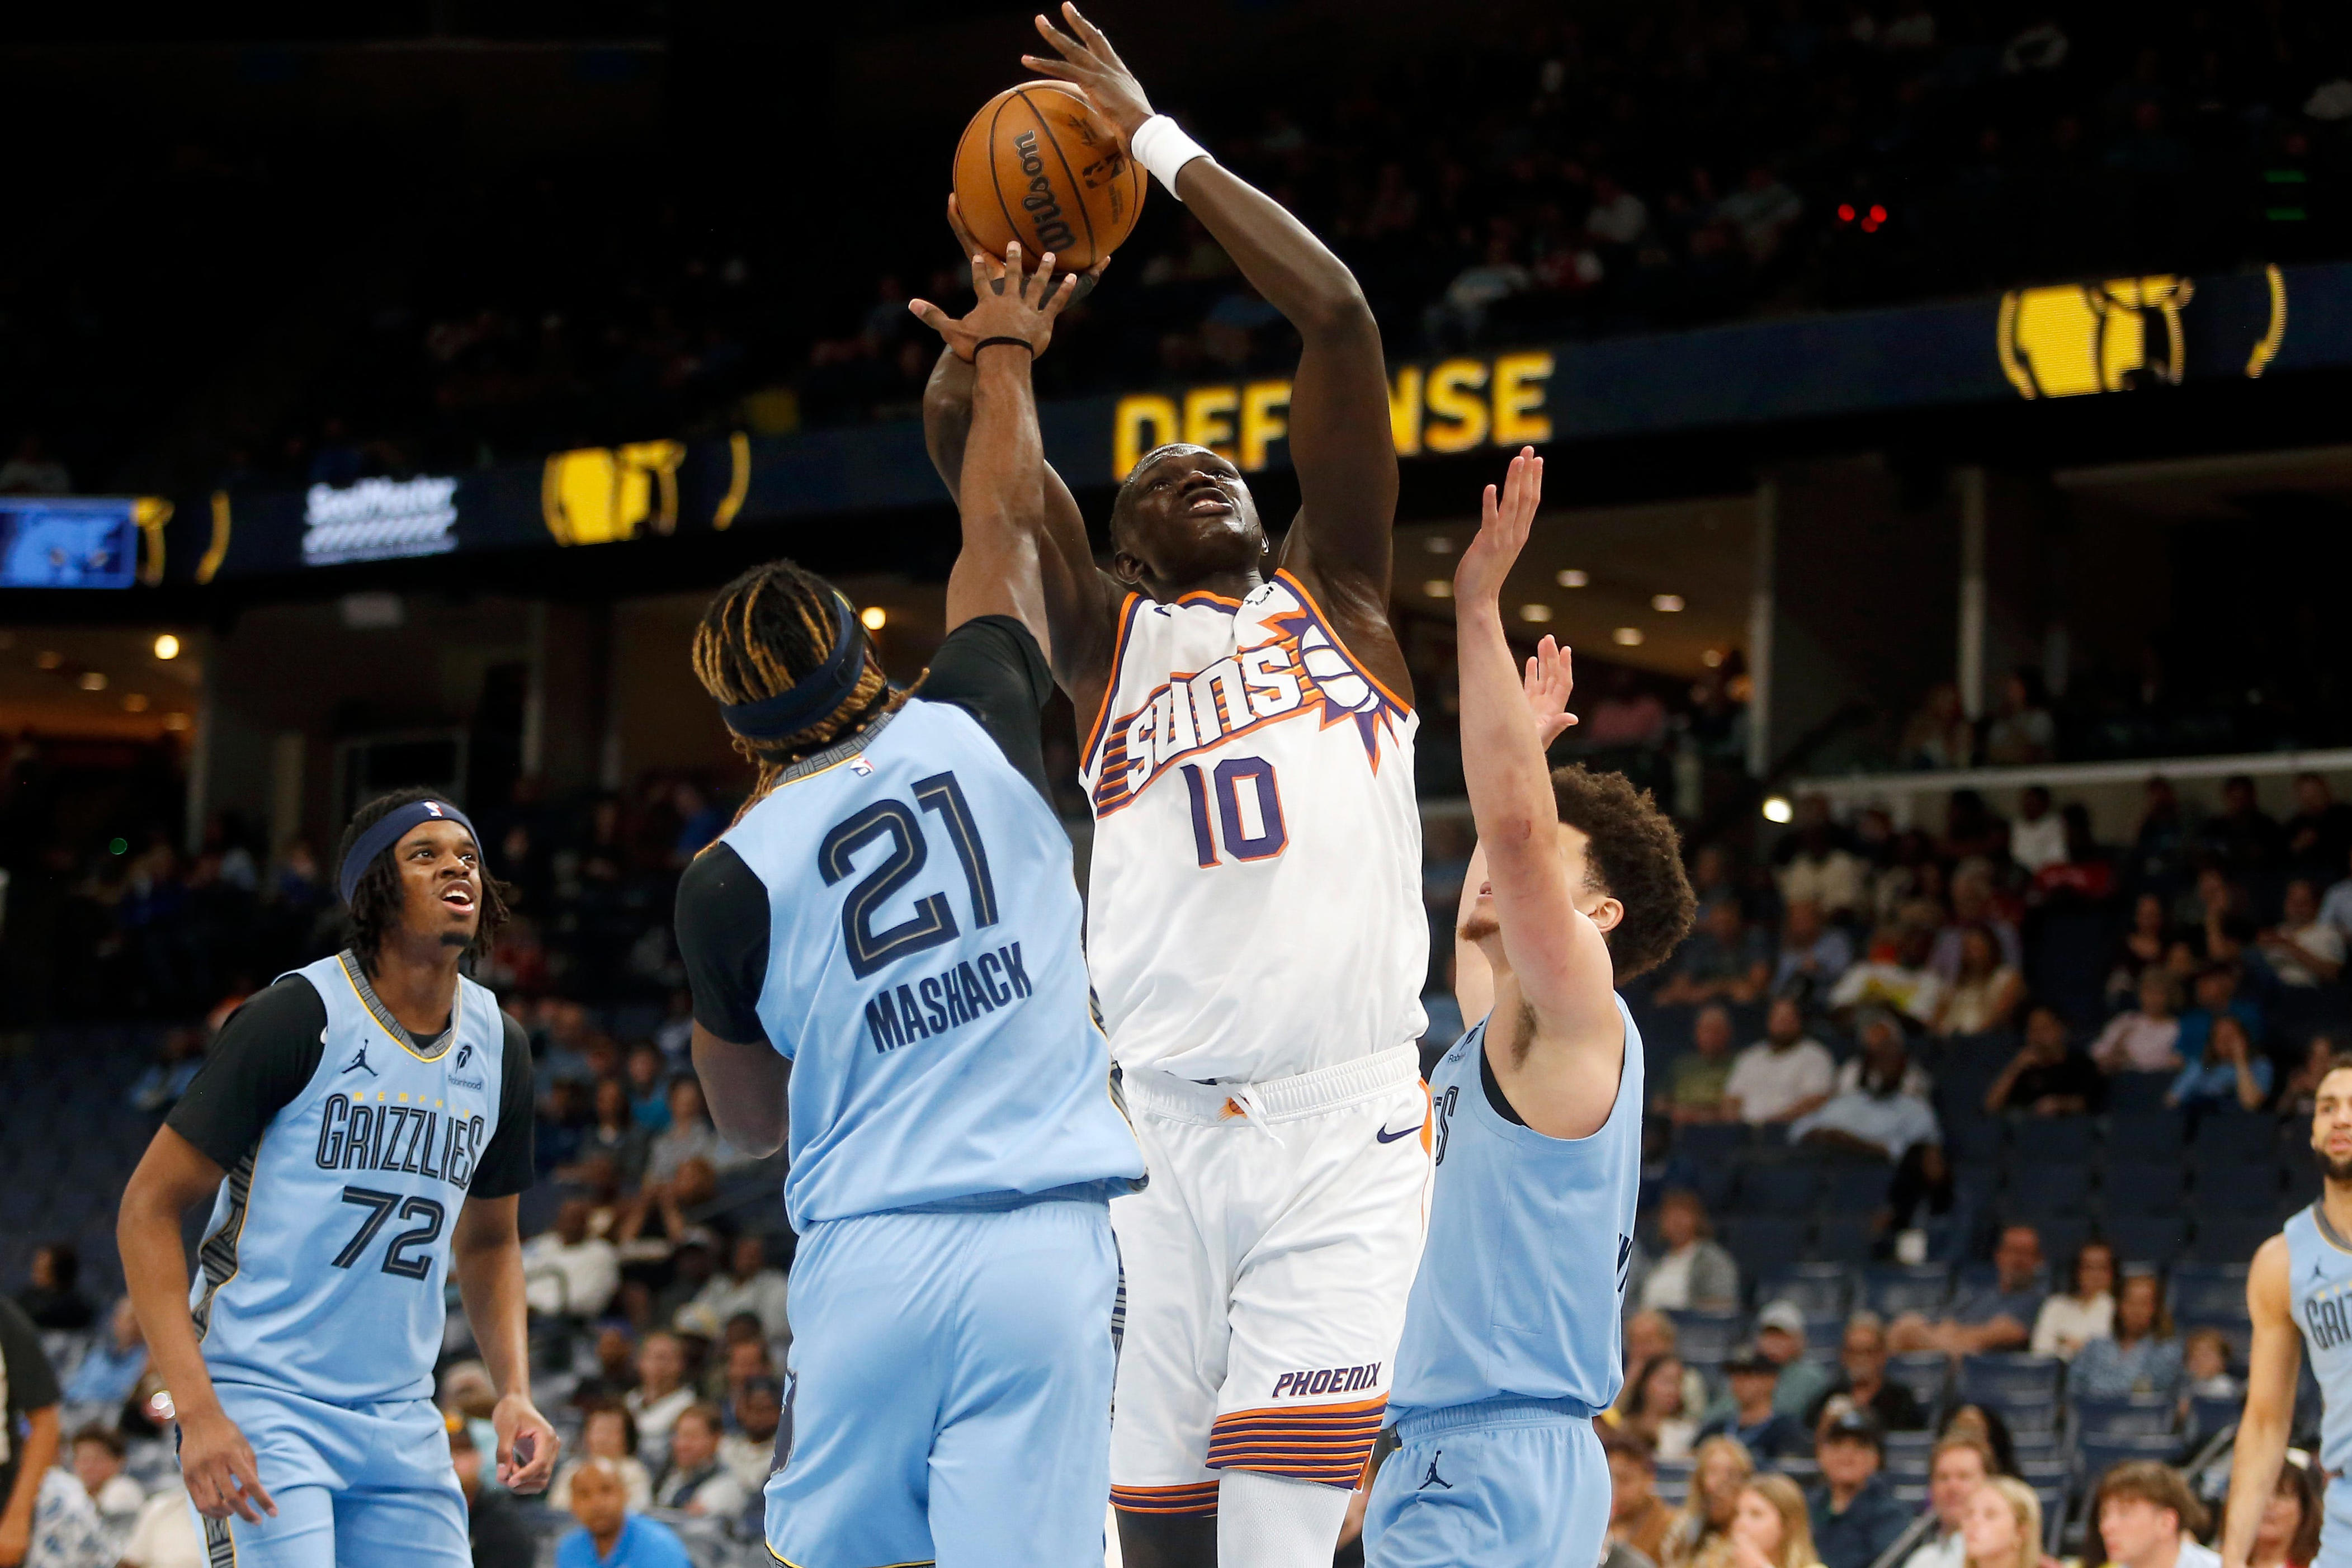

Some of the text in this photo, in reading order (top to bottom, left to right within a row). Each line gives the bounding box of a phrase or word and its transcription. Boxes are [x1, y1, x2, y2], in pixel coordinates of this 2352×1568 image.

[1014, 130, 1076, 253] Wilson
[1114, 351, 1556, 482] DEFNSE
[1126, 645, 1303, 795] SUNS
[1180, 756, 1289, 869] 10
[818, 770, 999, 981] 21
[865, 942, 1032, 1054] MASHACK
[316, 1093, 485, 1191] GRIZZLIES
[331, 1186, 445, 1281] 72
[1272, 1362, 1382, 1399] PHOENIX
